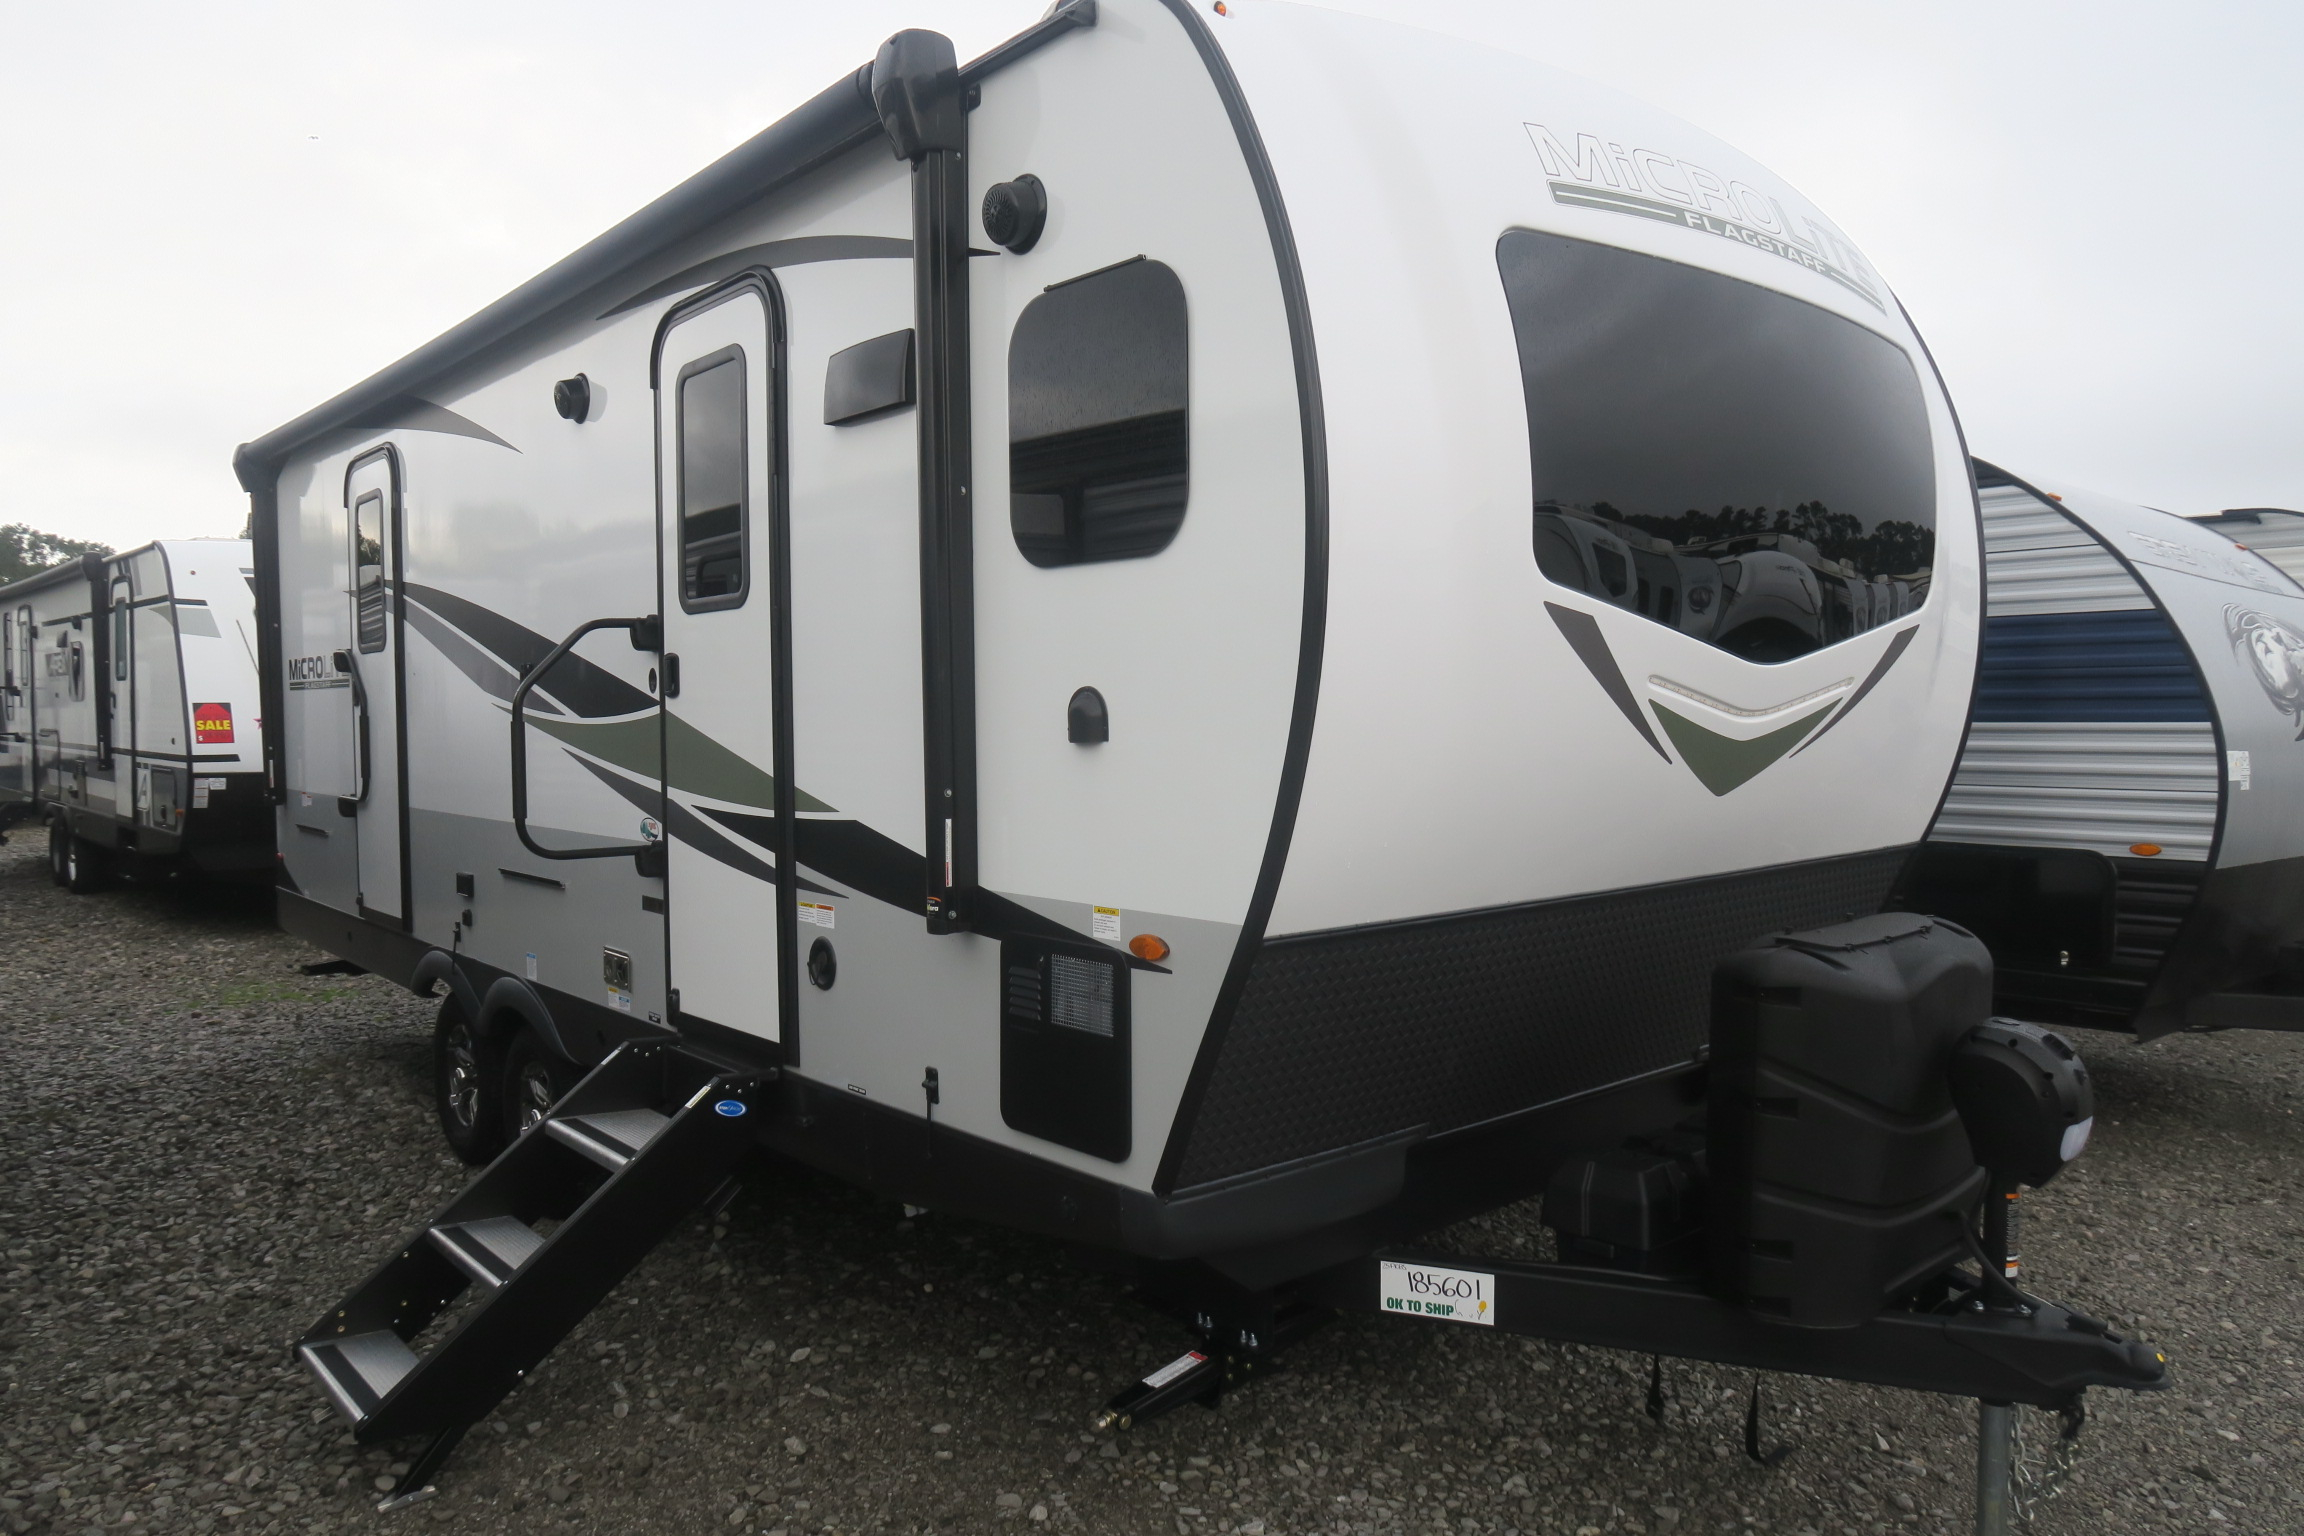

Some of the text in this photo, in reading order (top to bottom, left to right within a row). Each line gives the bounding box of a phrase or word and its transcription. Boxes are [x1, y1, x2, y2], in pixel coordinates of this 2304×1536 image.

[1683, 209, 1828, 275] FLAGSTAFF
[196, 720, 232, 731] SALE
[1407, 1271, 1481, 1300] 185601
[1386, 1296, 1455, 1316] OK TO SHIP
